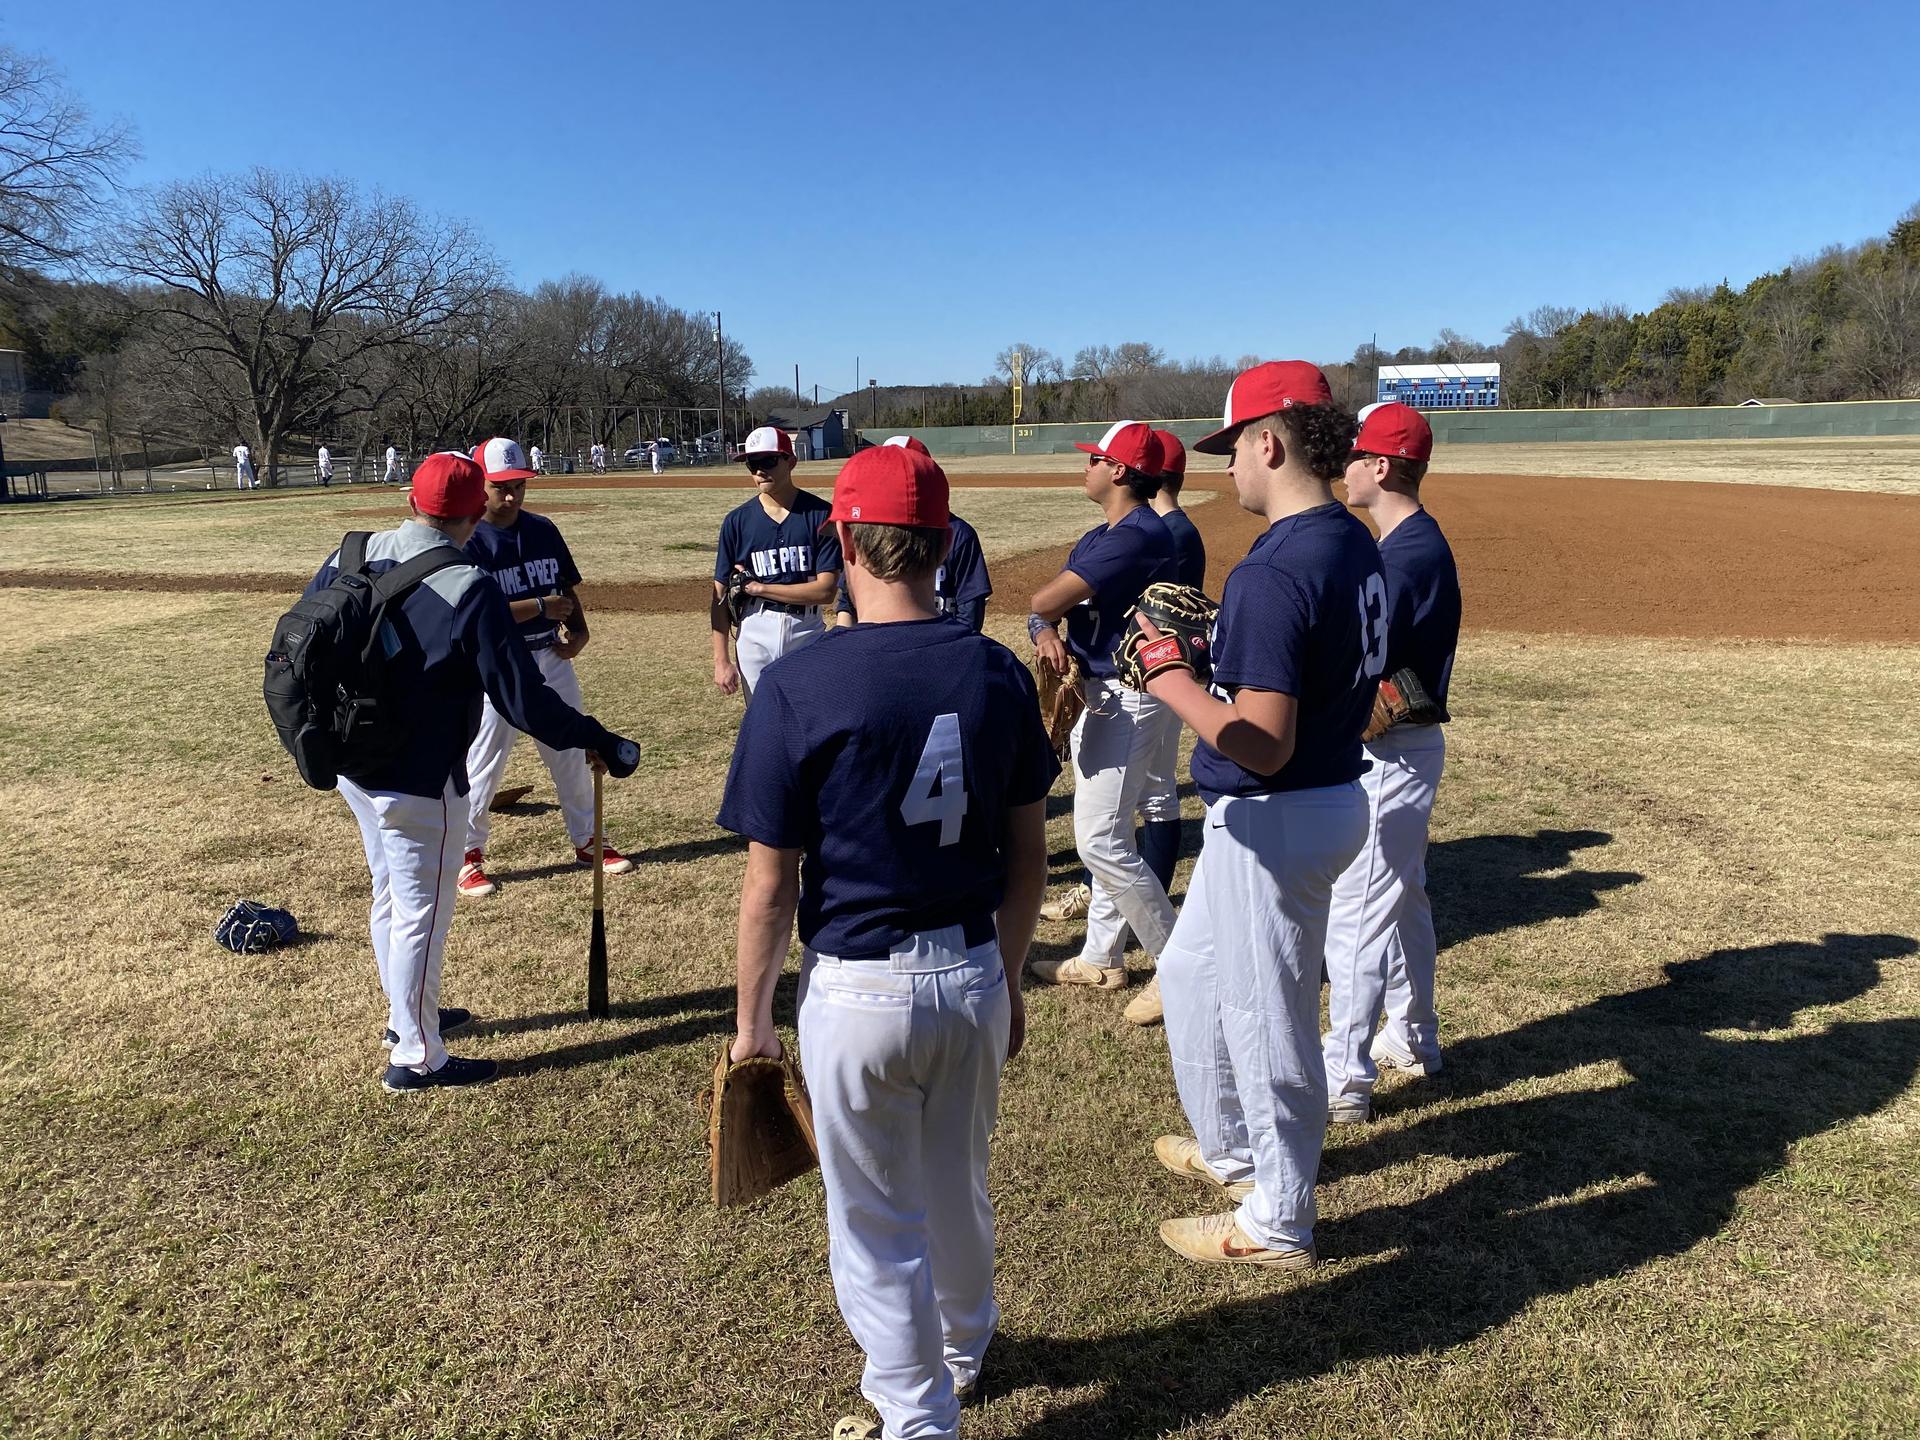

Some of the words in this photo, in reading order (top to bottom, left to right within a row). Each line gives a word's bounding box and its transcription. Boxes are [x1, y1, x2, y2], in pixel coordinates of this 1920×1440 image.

[1018, 429, 1033, 437] 331
[524, 558, 559, 588] PREP
[900, 712, 968, 849] 4
